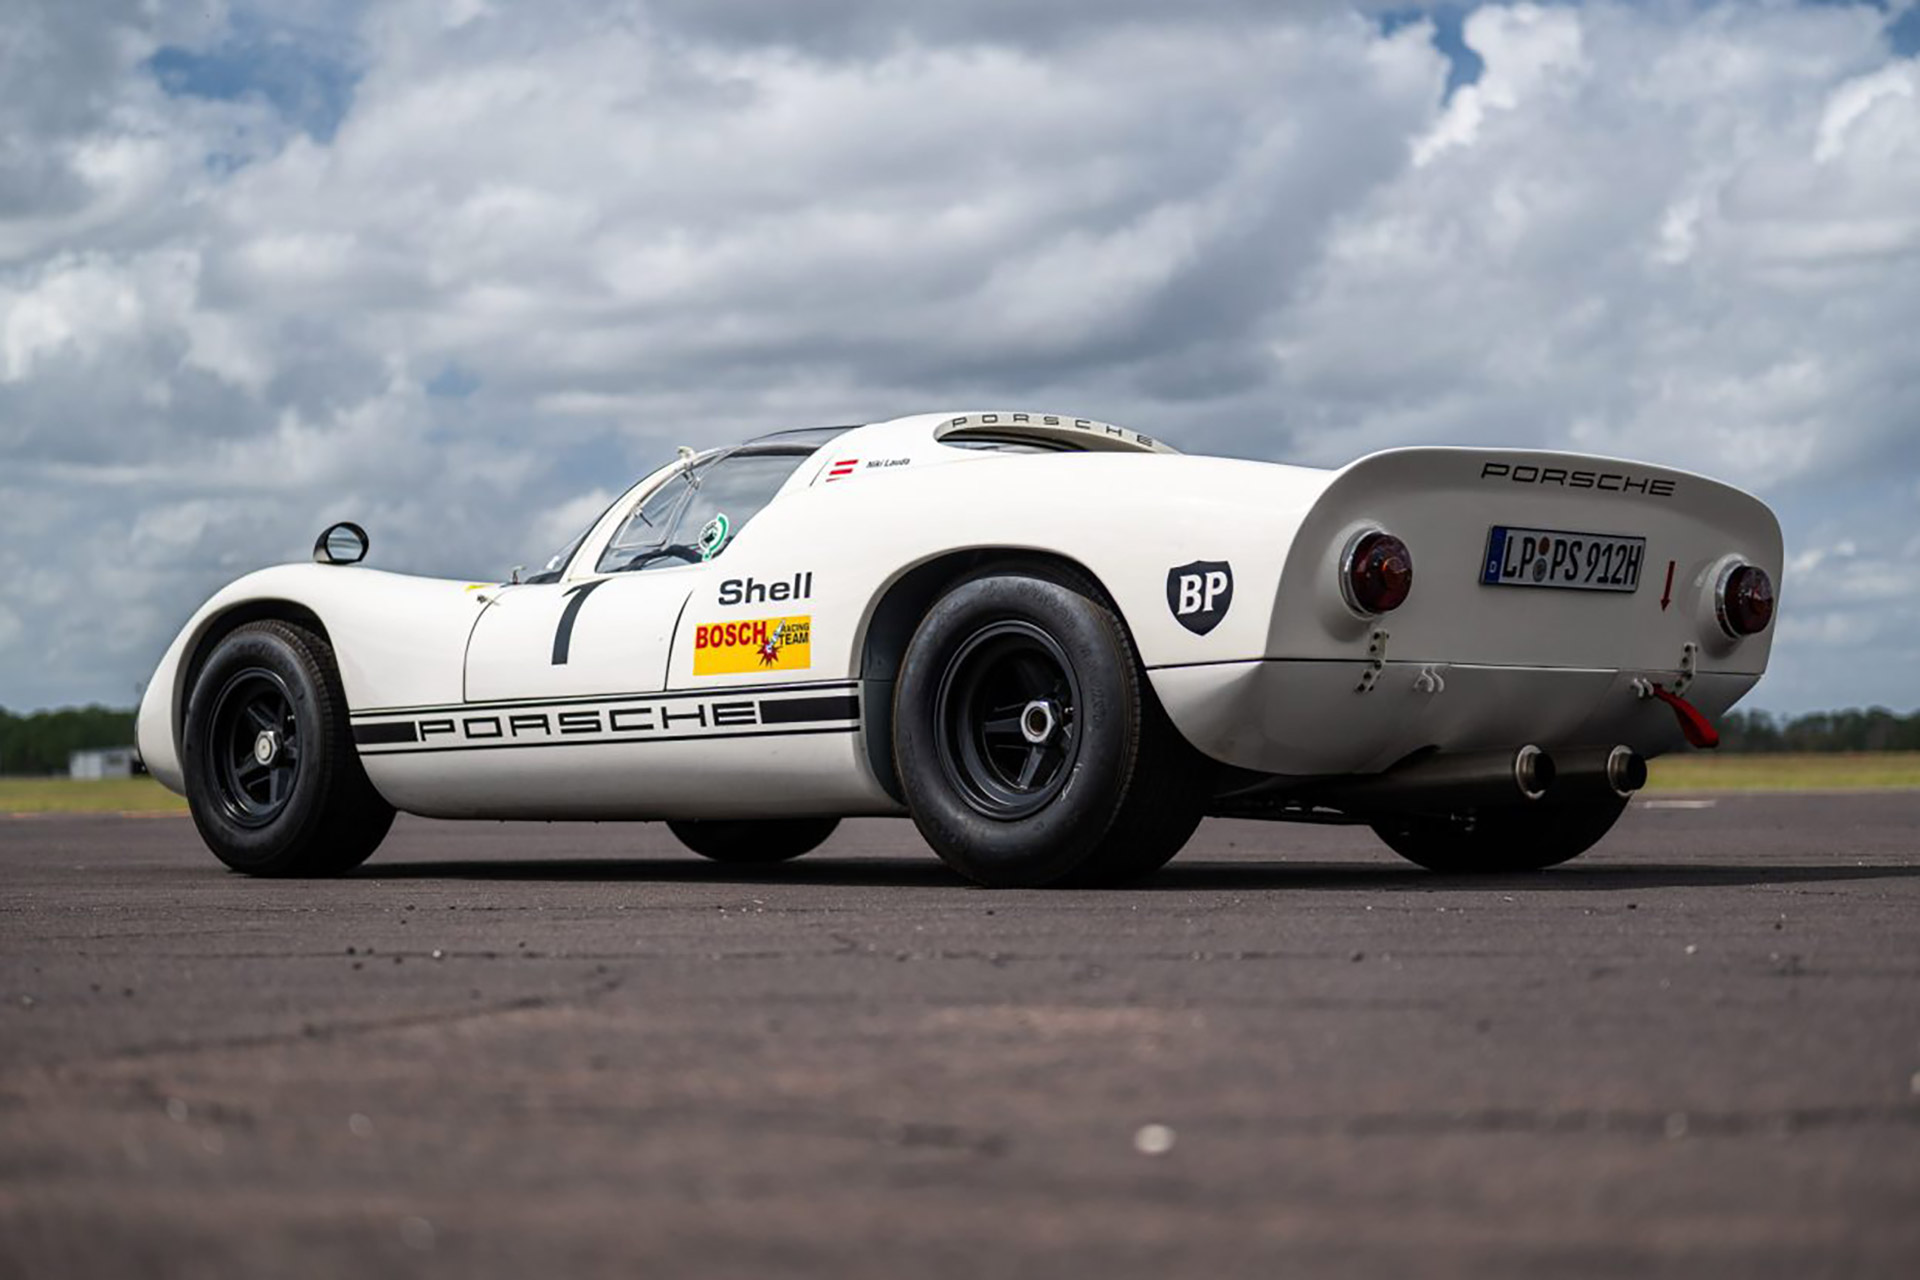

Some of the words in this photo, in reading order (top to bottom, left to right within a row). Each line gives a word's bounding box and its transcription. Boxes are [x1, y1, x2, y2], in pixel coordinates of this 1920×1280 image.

[952, 413, 1154, 446] PORSCHE
[1481, 462, 1676, 497] PORSCHE
[1502, 536, 1536, 578] LP
[1549, 538, 1583, 580] PS
[1584, 541, 1642, 585] 912H
[718, 571, 812, 606] Shell
[1177, 570, 1228, 615] BP
[695, 621, 767, 649] BOSCH
[779, 631, 809, 646] TEAM
[419, 701, 757, 742] PORSCHE
